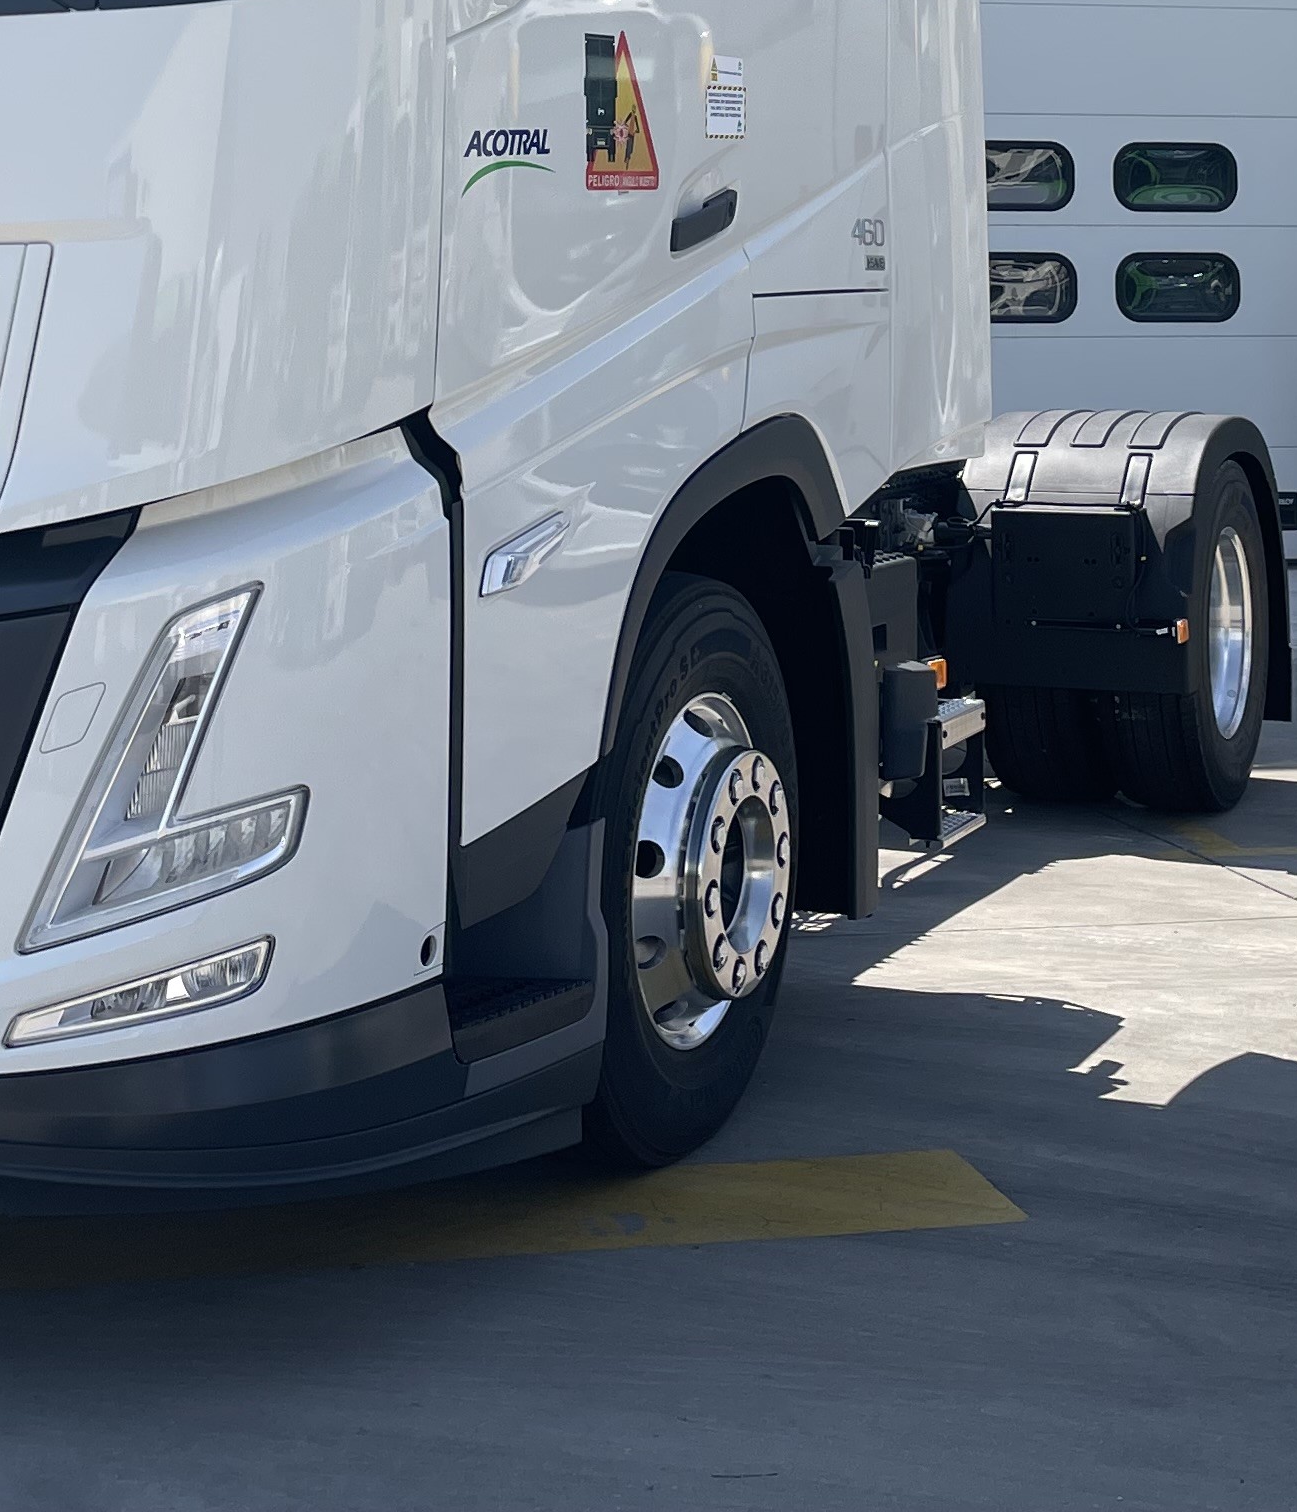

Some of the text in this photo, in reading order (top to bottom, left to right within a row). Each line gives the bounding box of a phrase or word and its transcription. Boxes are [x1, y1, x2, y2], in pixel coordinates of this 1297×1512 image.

[463, 129, 551, 157] ACOTRAL
[588, 174, 620, 187] PELIGRO
[851, 218, 885, 246] 460
